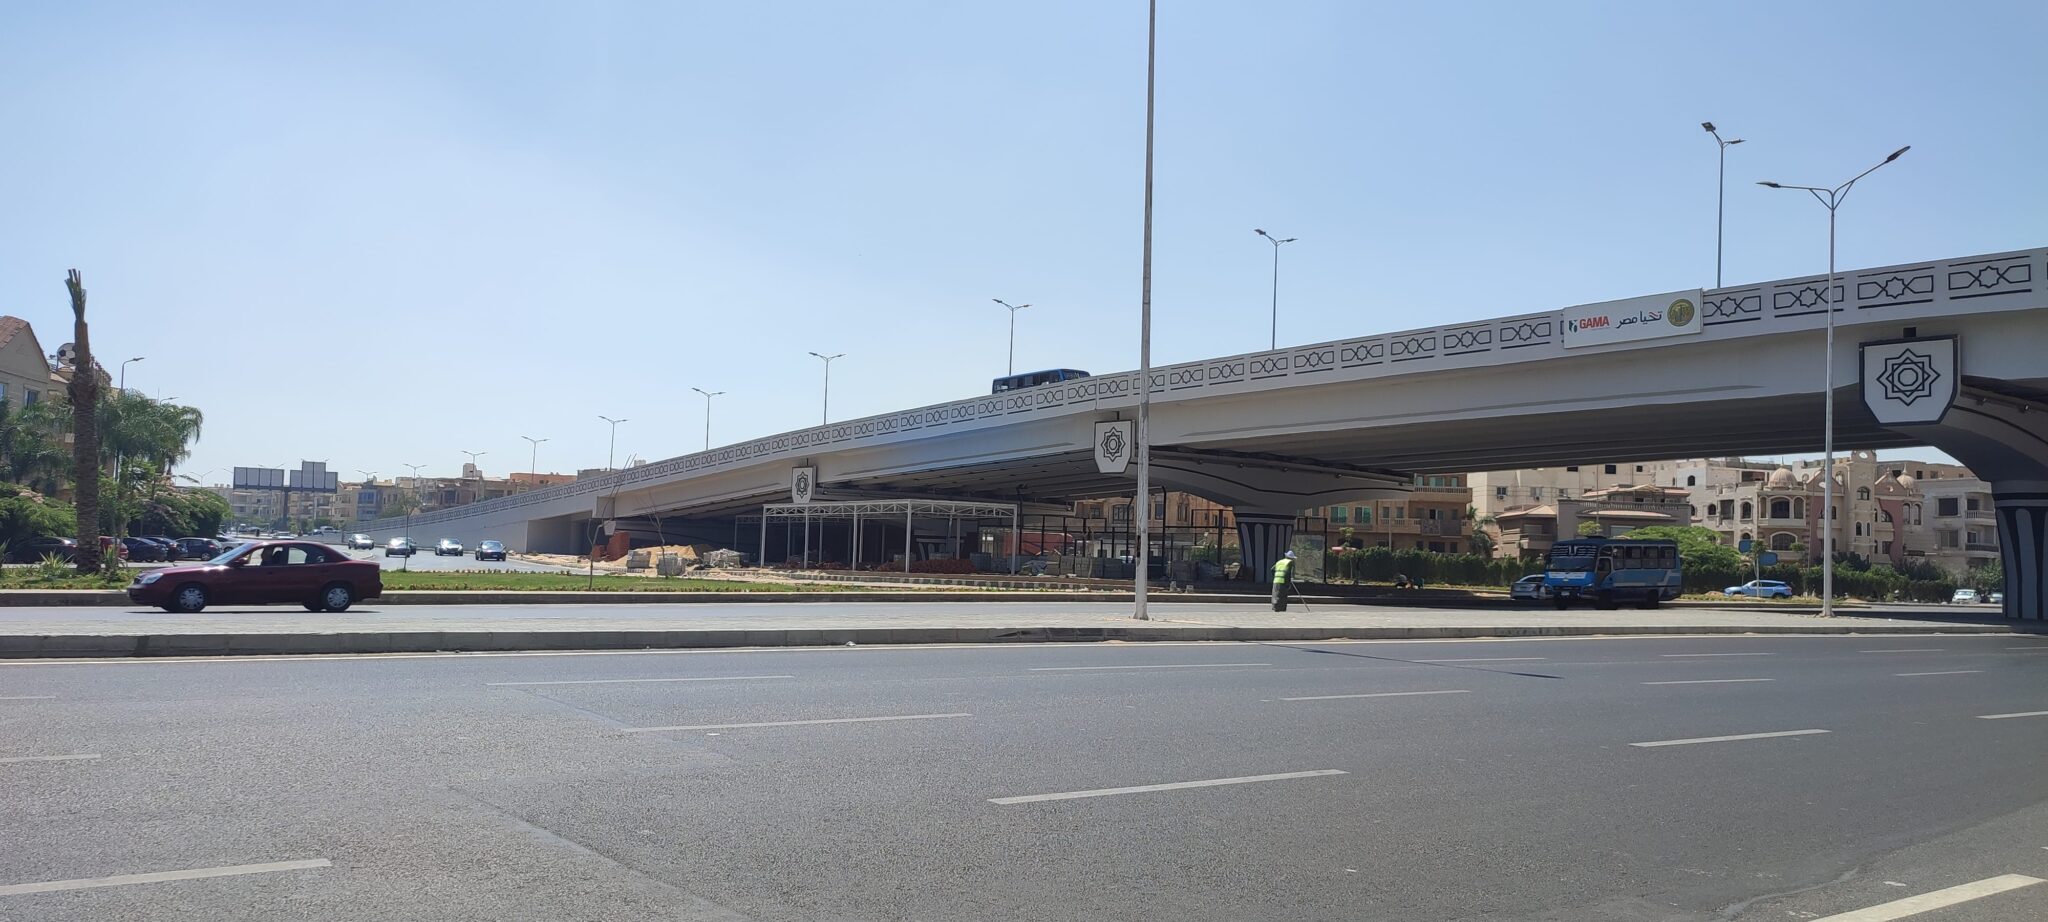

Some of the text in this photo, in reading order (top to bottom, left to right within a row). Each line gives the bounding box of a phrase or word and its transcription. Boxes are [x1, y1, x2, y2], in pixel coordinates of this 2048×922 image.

[1580, 316, 1610, 329] GAMA
[1615, 310, 1663, 329] تحيا مصر
